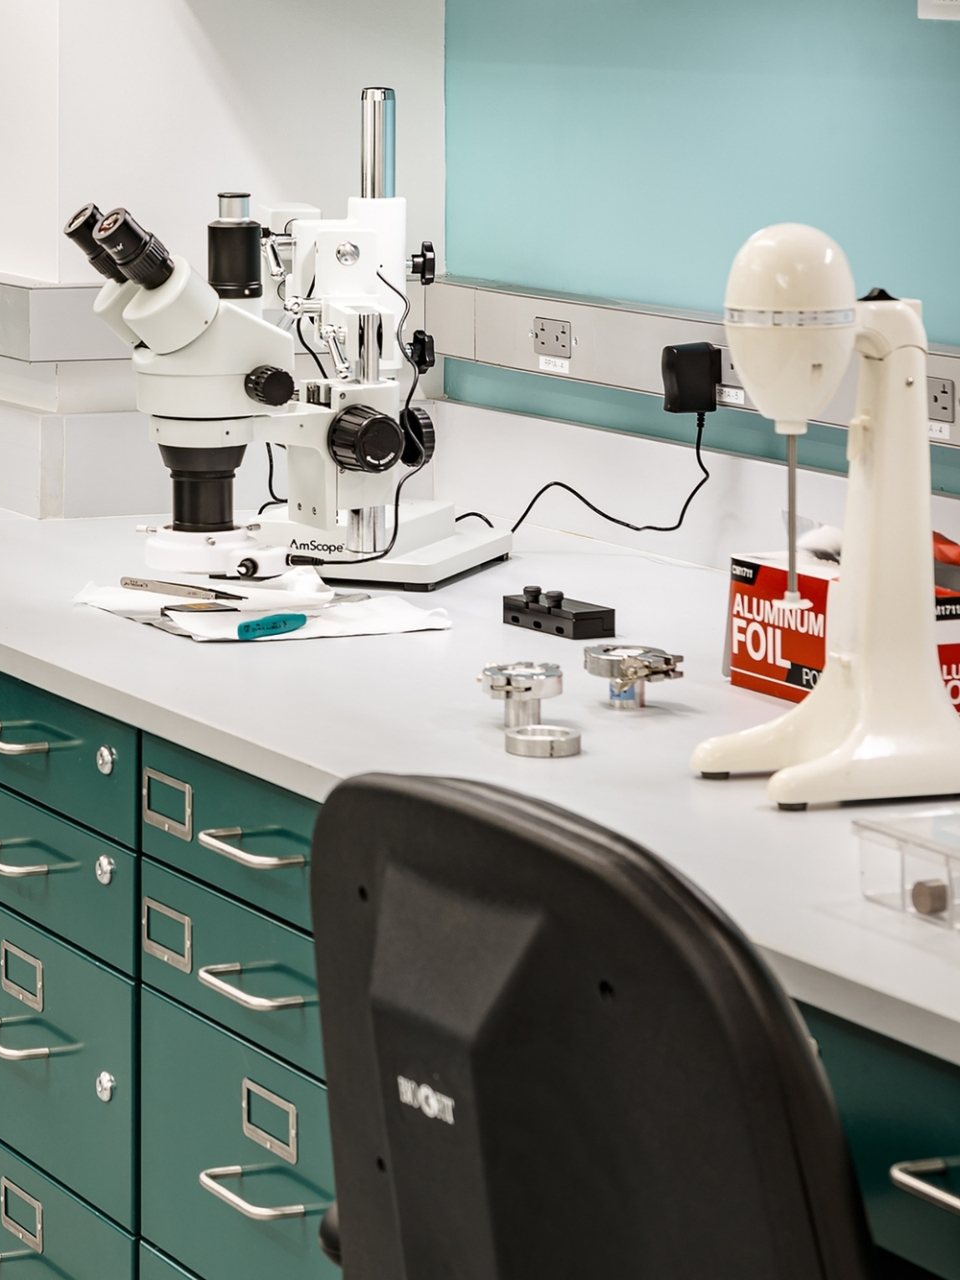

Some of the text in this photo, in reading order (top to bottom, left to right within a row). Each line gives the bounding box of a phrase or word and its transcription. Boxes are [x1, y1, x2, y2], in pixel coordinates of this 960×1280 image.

[733, 592, 825, 638] ALUMINUM
[935, 605, 960, 616] M1711
[732, 616, 792, 669] FOIL
